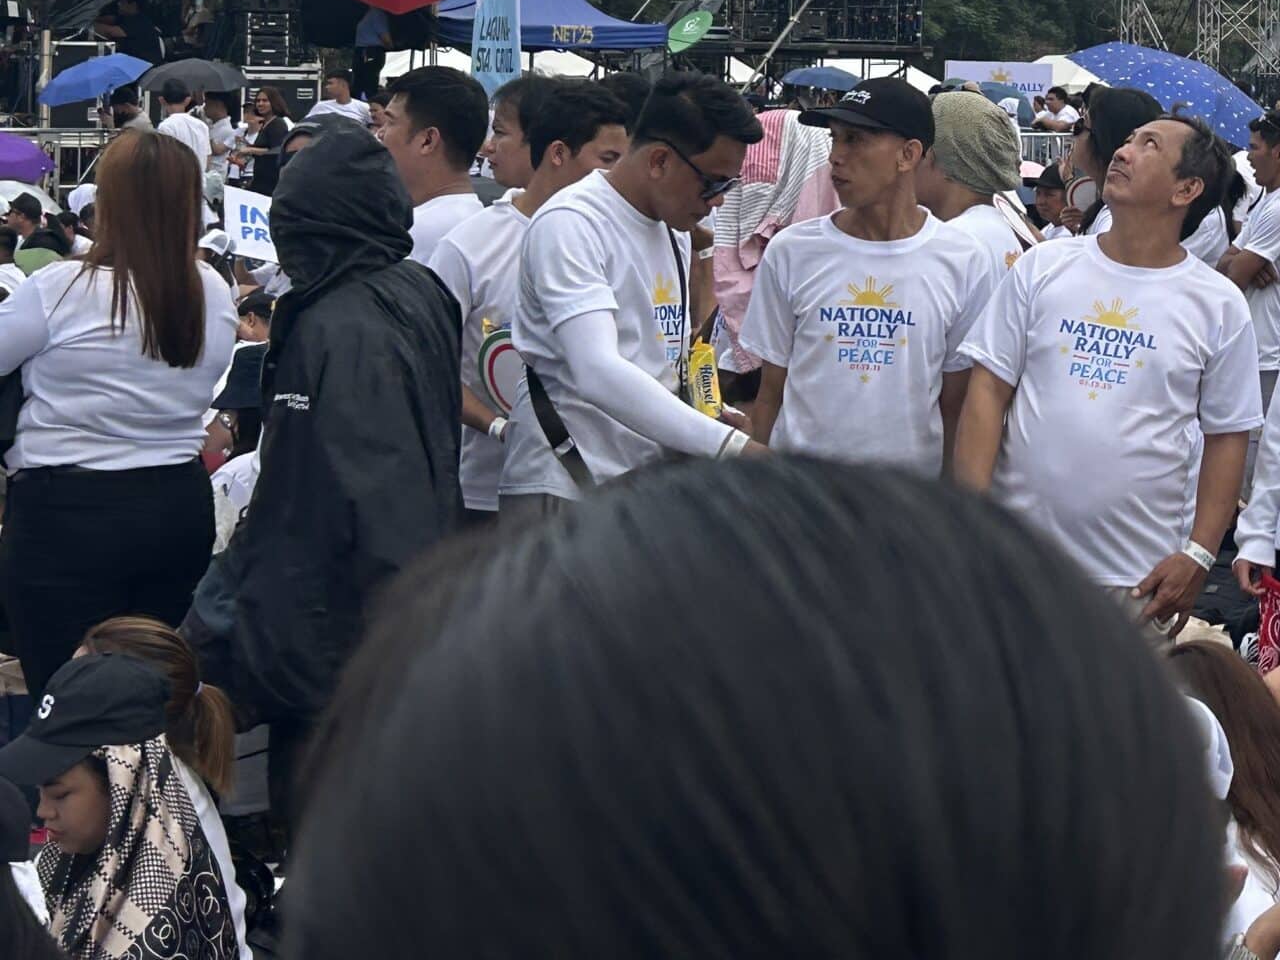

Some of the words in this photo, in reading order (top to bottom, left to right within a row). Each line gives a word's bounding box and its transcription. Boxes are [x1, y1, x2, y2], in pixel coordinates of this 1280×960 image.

[552, 24, 594, 44] NET25
[820, 306, 916, 326] NATIONAL
[838, 322, 898, 339] RALLY
[1059, 318, 1157, 350] NATIONAL
[857, 339, 878, 348] FOR
[1074, 336, 1136, 360] RALLY
[838, 348, 894, 365] PEACE
[1090, 356, 1112, 368] FOR
[1069, 362, 1128, 385] PEACE
[699, 365, 717, 404] Hansel
[38, 694, 55, 719] S
